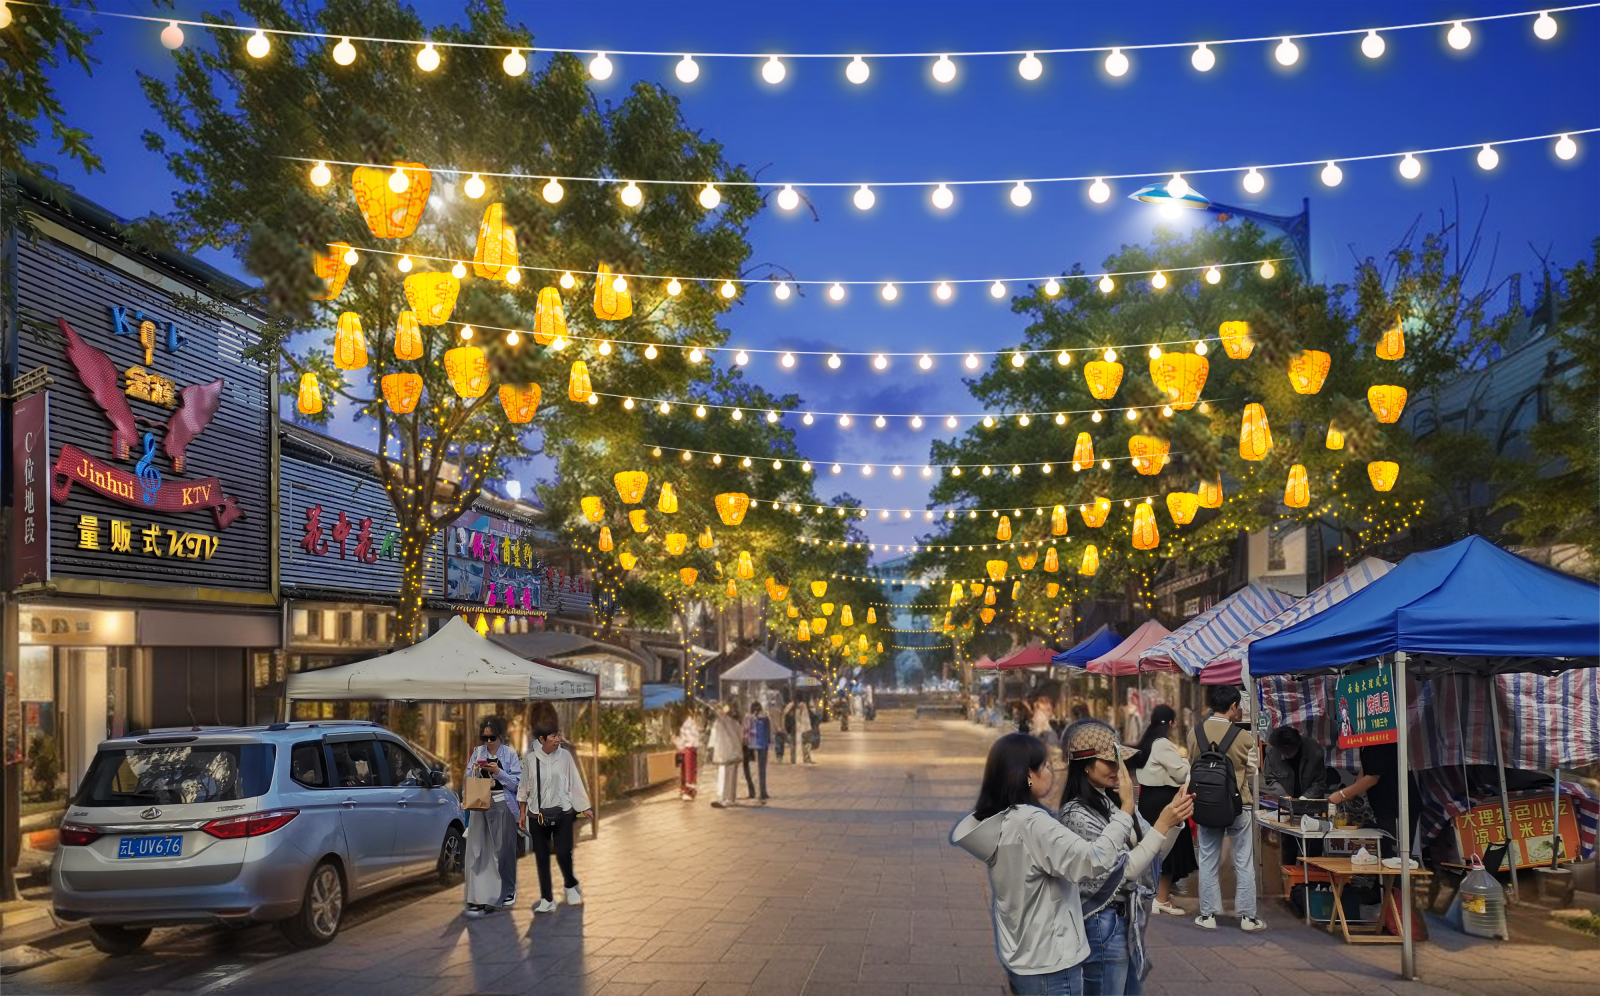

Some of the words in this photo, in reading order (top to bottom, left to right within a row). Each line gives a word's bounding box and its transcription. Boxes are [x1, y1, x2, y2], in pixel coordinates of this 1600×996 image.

[24, 431, 35, 544] C位地段
[77, 458, 134, 500] Jinhui
[182, 483, 212, 506] KTV
[77, 514, 219, 561] 量贩式KTV
[300, 503, 405, 564] 花中花K
[1347, 674, 1389, 694] 云南大理风味
[1366, 690, 1391, 717] 烤乳扇
[1460, 800, 1569, 829] 大理特色小吃
